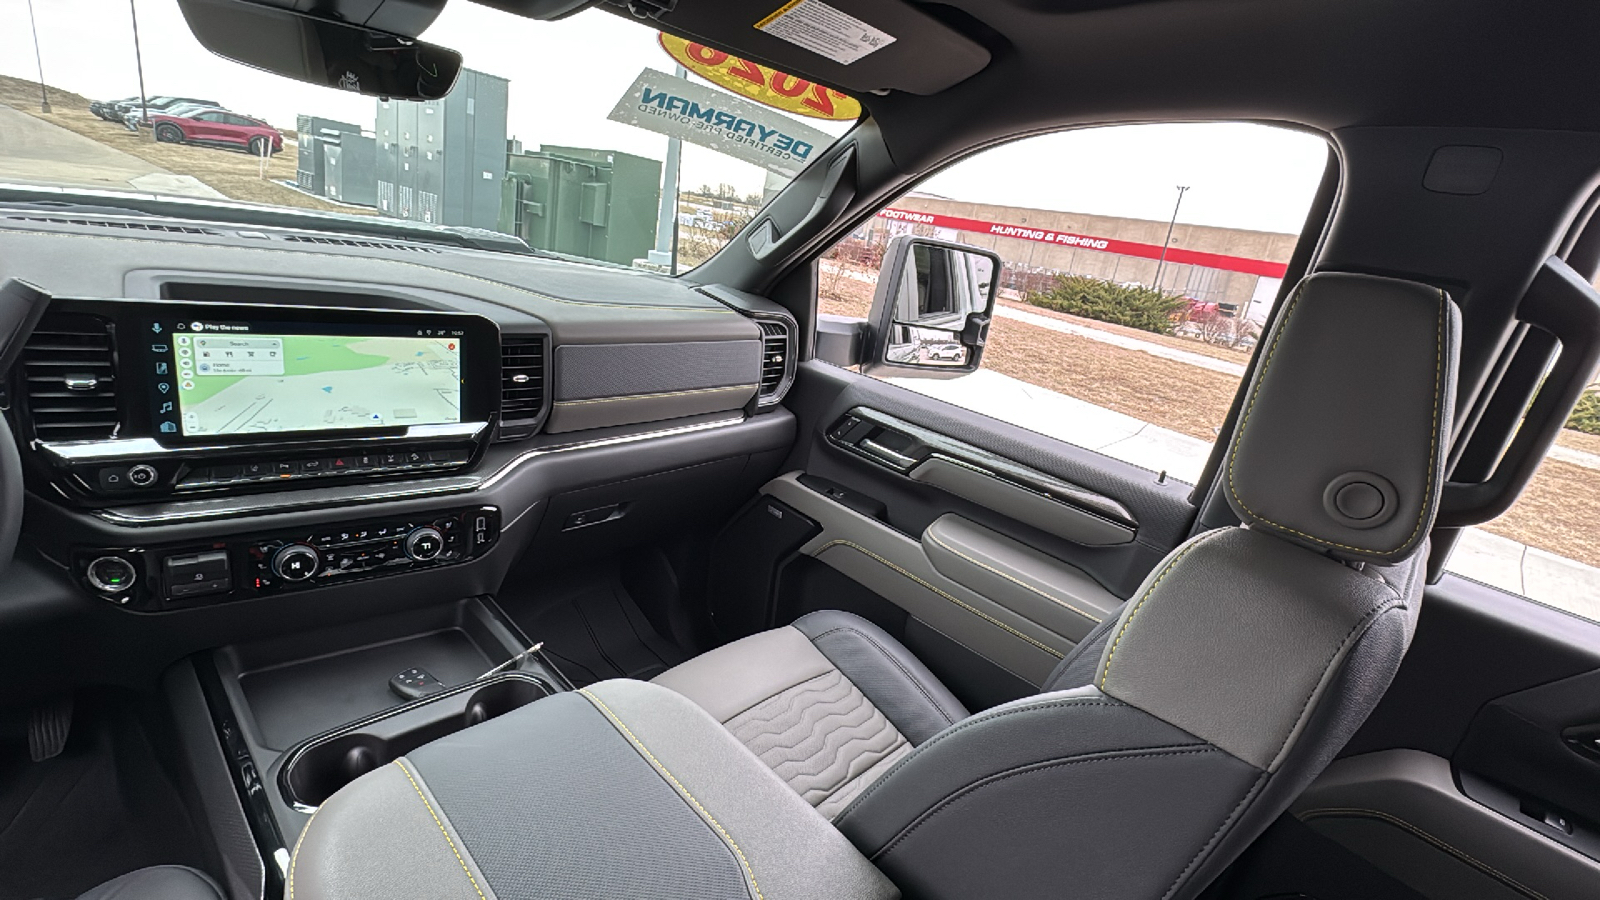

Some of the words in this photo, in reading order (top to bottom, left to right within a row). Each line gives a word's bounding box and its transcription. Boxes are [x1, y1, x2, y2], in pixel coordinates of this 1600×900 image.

[879, 210, 935, 224] FOOTWEAR
[990, 225, 1044, 240] HUNTING
[1044, 231, 1055, 241] &
[1056, 234, 1109, 249] FISHING
[204, 323, 219, 331] Play
